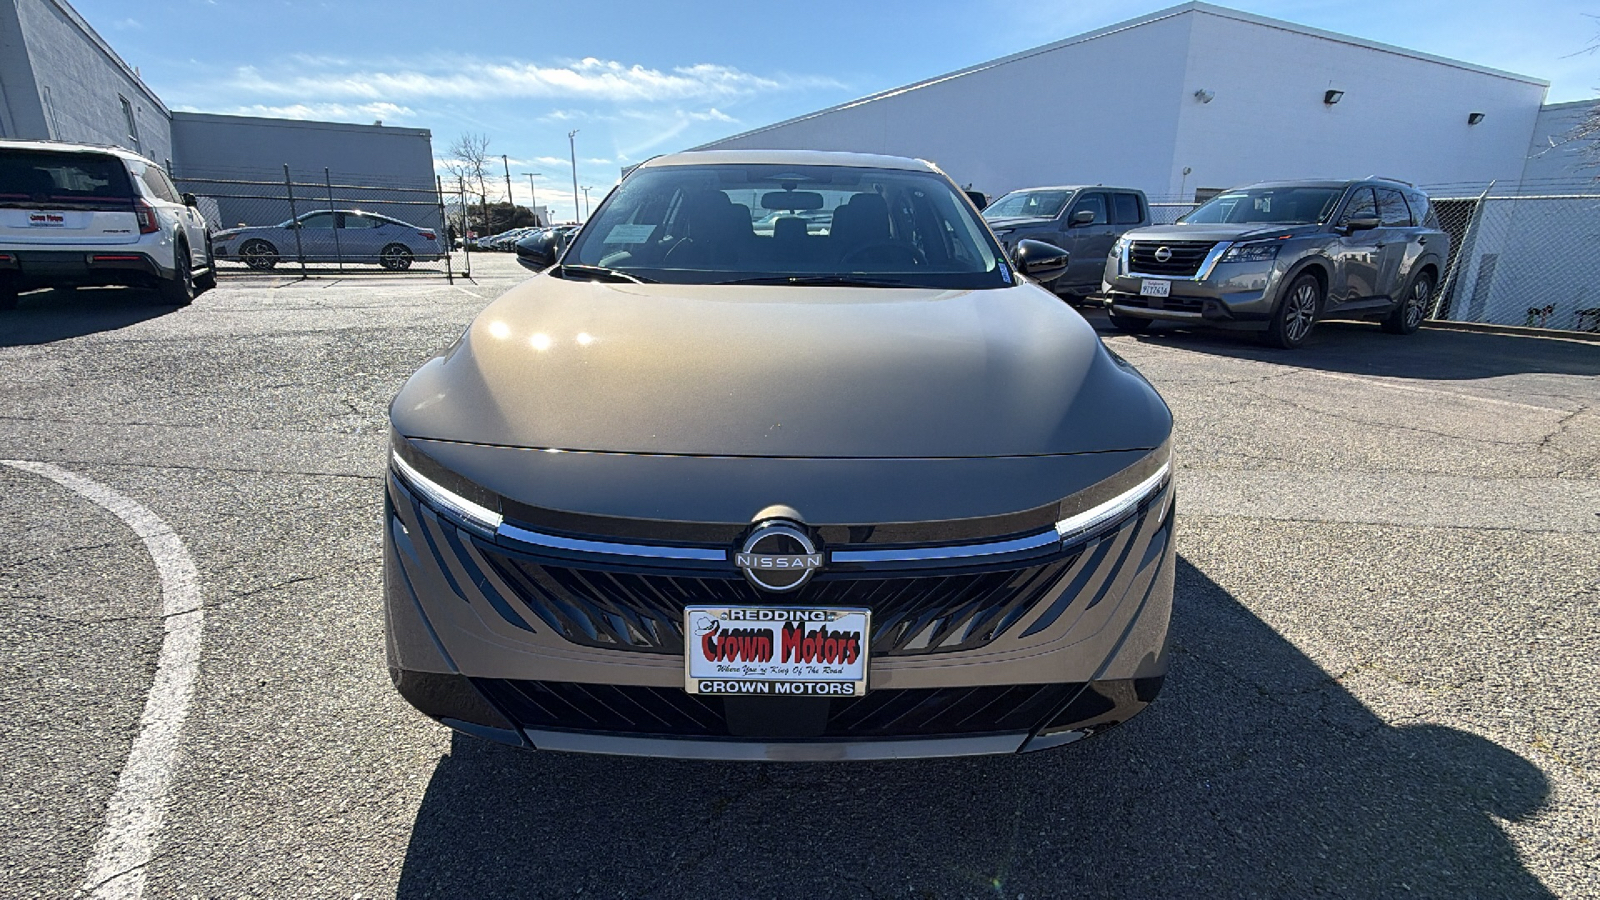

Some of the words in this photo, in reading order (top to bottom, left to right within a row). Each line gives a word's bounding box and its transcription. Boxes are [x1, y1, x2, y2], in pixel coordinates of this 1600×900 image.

[737, 555, 820, 568] NISSAN
[730, 610, 826, 621] REDDING
[702, 619, 774, 663] Crown
[781, 621, 861, 665] Motors
[716, 664, 740, 673] Where
[742, 664, 768, 676] You're
[770, 666, 789, 676] King
[792, 666, 803, 675] Of
[805, 666, 819, 674] The
[822, 666, 844, 674] Road
[699, 681, 769, 694] CROWN
[775, 682, 854, 694] MOTORS
